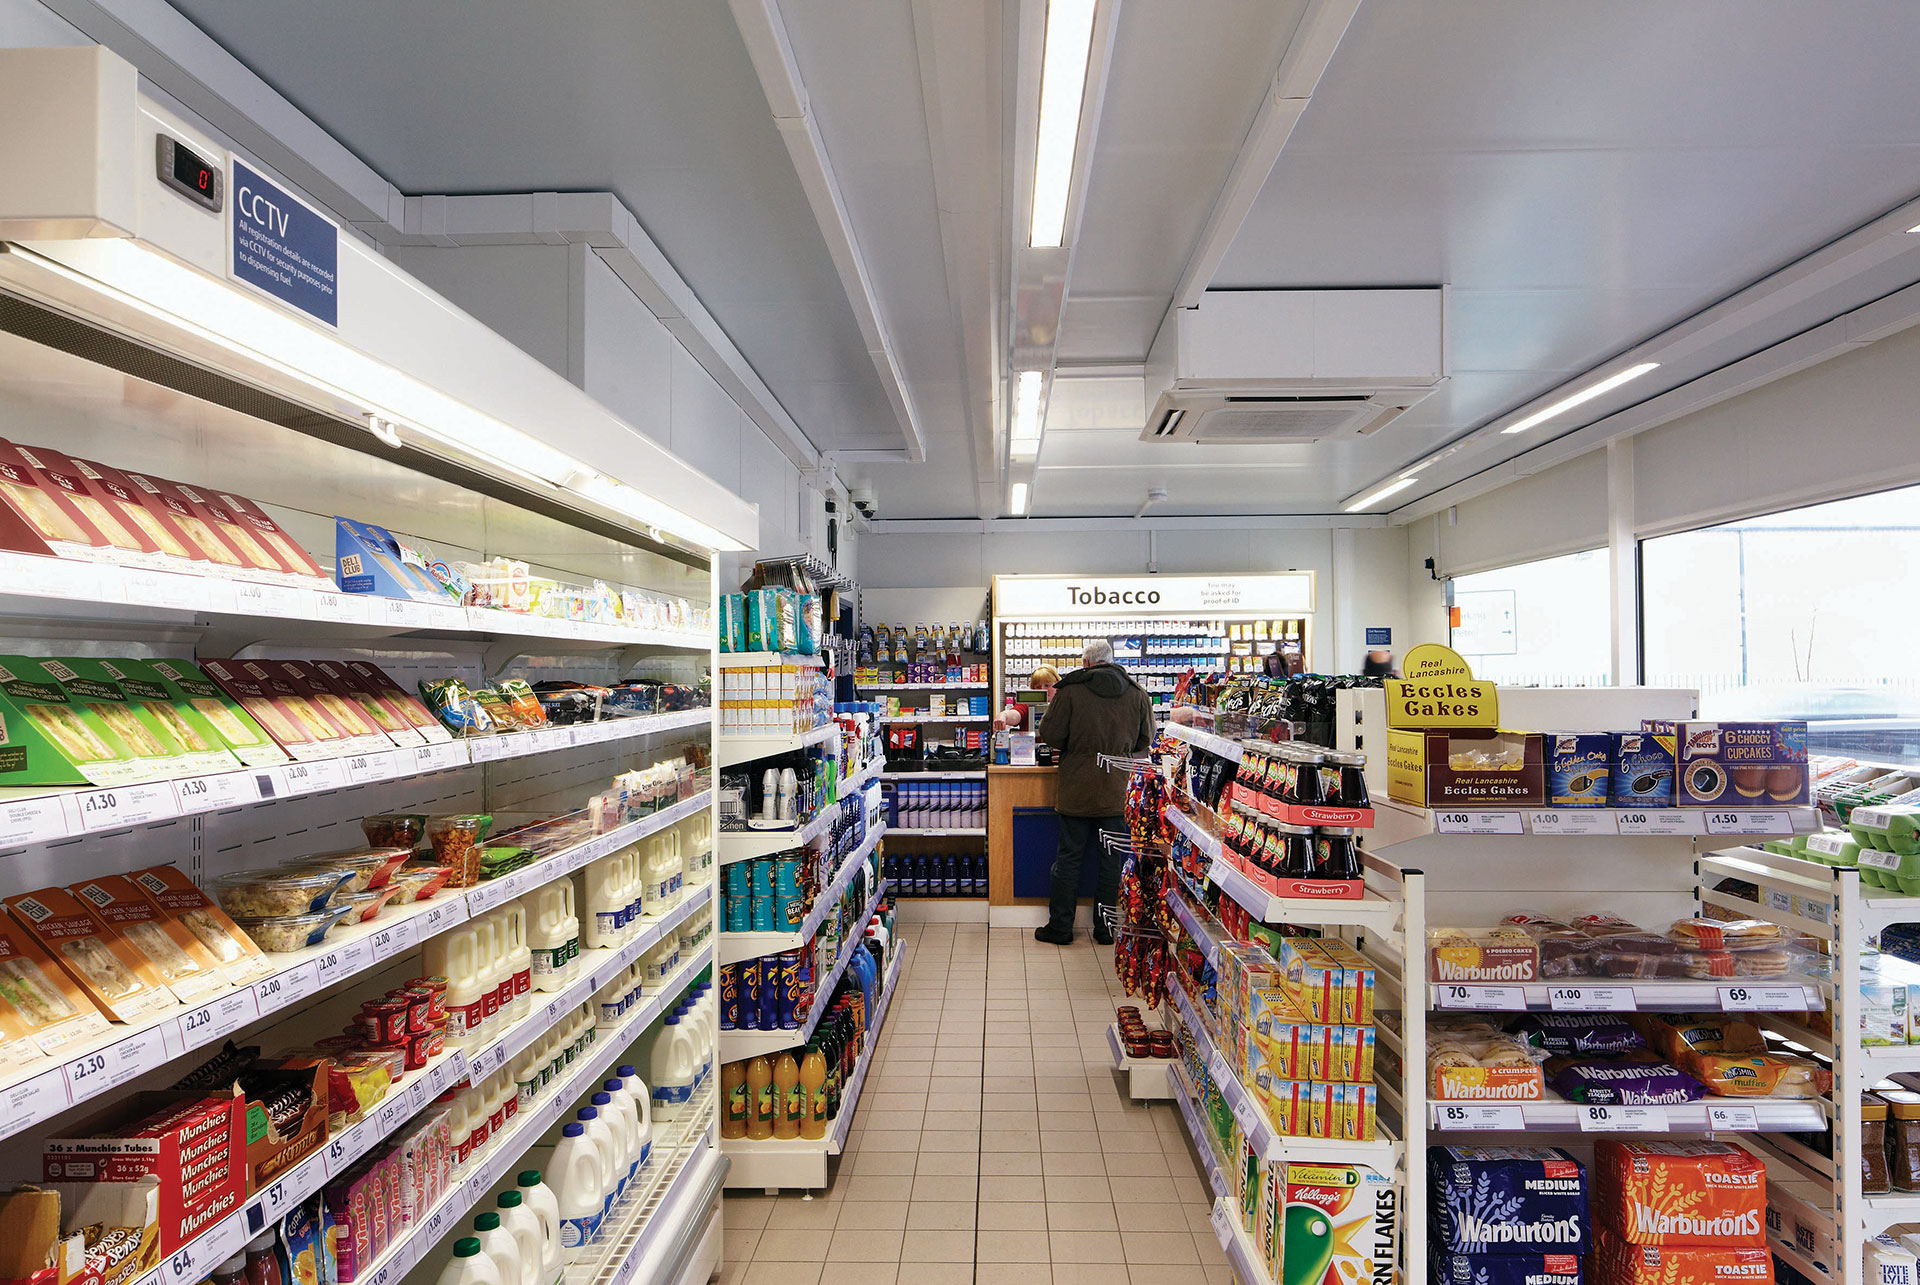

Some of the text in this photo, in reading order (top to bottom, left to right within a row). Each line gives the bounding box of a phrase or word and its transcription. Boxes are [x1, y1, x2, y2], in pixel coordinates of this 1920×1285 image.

[238, 186, 289, 238] CCTV
[239, 219, 334, 282] All registration details are recorded
[239, 235, 334, 295] via CCTV for security purposes prior
[239, 251, 293, 287] to dispensing fuel.
[342, 557, 359, 568] DELI
[344, 564, 361, 576] CLUB
[1066, 586, 1161, 605] Tobacco
[1420, 659, 1443, 669] Real
[1409, 666, 1465, 680] Lancashire
[1399, 683, 1482, 699] Eccles
[1404, 700, 1479, 717] Cakes
[1725, 730, 1771, 745] 6 CHOCCY
[1389, 743, 1418, 756] Real Lancashire
[1727, 746, 1772, 760] CUPCAKES
[351, 757, 367, 770] £2.00
[1387, 757, 1423, 773] Eccles Cakes
[1554, 760, 1561, 773] 6
[1560, 755, 1586, 773] Golden
[1621, 752, 1664, 774] 6 Choco
[289, 766, 308, 780] £2.00
[1455, 777, 1518, 785] Real Lancashire
[182, 780, 207, 797] £1.30
[1444, 786, 1529, 795] Eccles Cakes
[86, 793, 117, 812] £1.30
[1310, 809, 1355, 821] Strawberry
[1442, 814, 1469, 824] £1.00
[1533, 814, 1559, 824] £1.00
[1620, 814, 1647, 824] £1.00
[1712, 814, 1738, 824] £1.50
[180, 892, 201, 900] SAUSAGE
[1299, 885, 1344, 895] Strawberry
[124, 904, 151, 913] SAUSAGE
[125, 910, 151, 920] STUFFING
[50, 925, 92, 937] AND STUFFING
[64, 919, 93, 929] SAUSAGE
[375, 932, 390, 948] £2.00
[319, 953, 337, 972] £2.00
[1437, 957, 1533, 981] Warburtons
[261, 979, 281, 1000] £2.00
[1448, 986, 1471, 999] 70p
[1554, 989, 1581, 1000] £1.00
[1729, 988, 1752, 1001] 69p
[186, 1009, 211, 1032] £2.20
[74, 1054, 105, 1080] £2.30
[1572, 1063, 1679, 1082] Warburtons
[1723, 1066, 1757, 1080] KINGSMILL
[1442, 1077, 1539, 1100] Warburtons
[1734, 1079, 1767, 1088] muffins
[1446, 1107, 1469, 1120] 85p
[1589, 1106, 1612, 1120] 80p
[1714, 1110, 1728, 1121] 66p
[179, 1110, 227, 1145] Munchies
[49, 1143, 153, 1153] 36 x Munchies Tubes
[180, 1130, 228, 1165] Munchies
[276, 1129, 315, 1167] Ripple
[330, 1141, 345, 1160] 45p
[135, 1165, 149, 1174] 52g
[181, 1146, 229, 1182] Munchies
[182, 1162, 229, 1198] Munchies
[418, 1148, 427, 1203] Vimto
[1292, 1168, 1357, 1185] Vitamin D
[1704, 1173, 1758, 1185] TOASTIE
[391, 1162, 402, 1222] Vimto
[1525, 1180, 1580, 1191] MEDIUM
[270, 1183, 288, 1206] 57p
[1294, 1186, 1341, 1205] Kellogg's
[180, 1190, 235, 1240] Munchies
[375, 1177, 386, 1239] Vimto
[356, 1193, 369, 1255] Vimto
[1373, 1189, 1396, 1258] FLAKES
[1458, 1210, 1581, 1243] Warburtons
[1634, 1201, 1761, 1236] Warburtons
[172, 1250, 196, 1277] 64p
[1715, 1264, 1767, 1275] TOASTIE
[1525, 1274, 1578, 1285] MEDIUM
